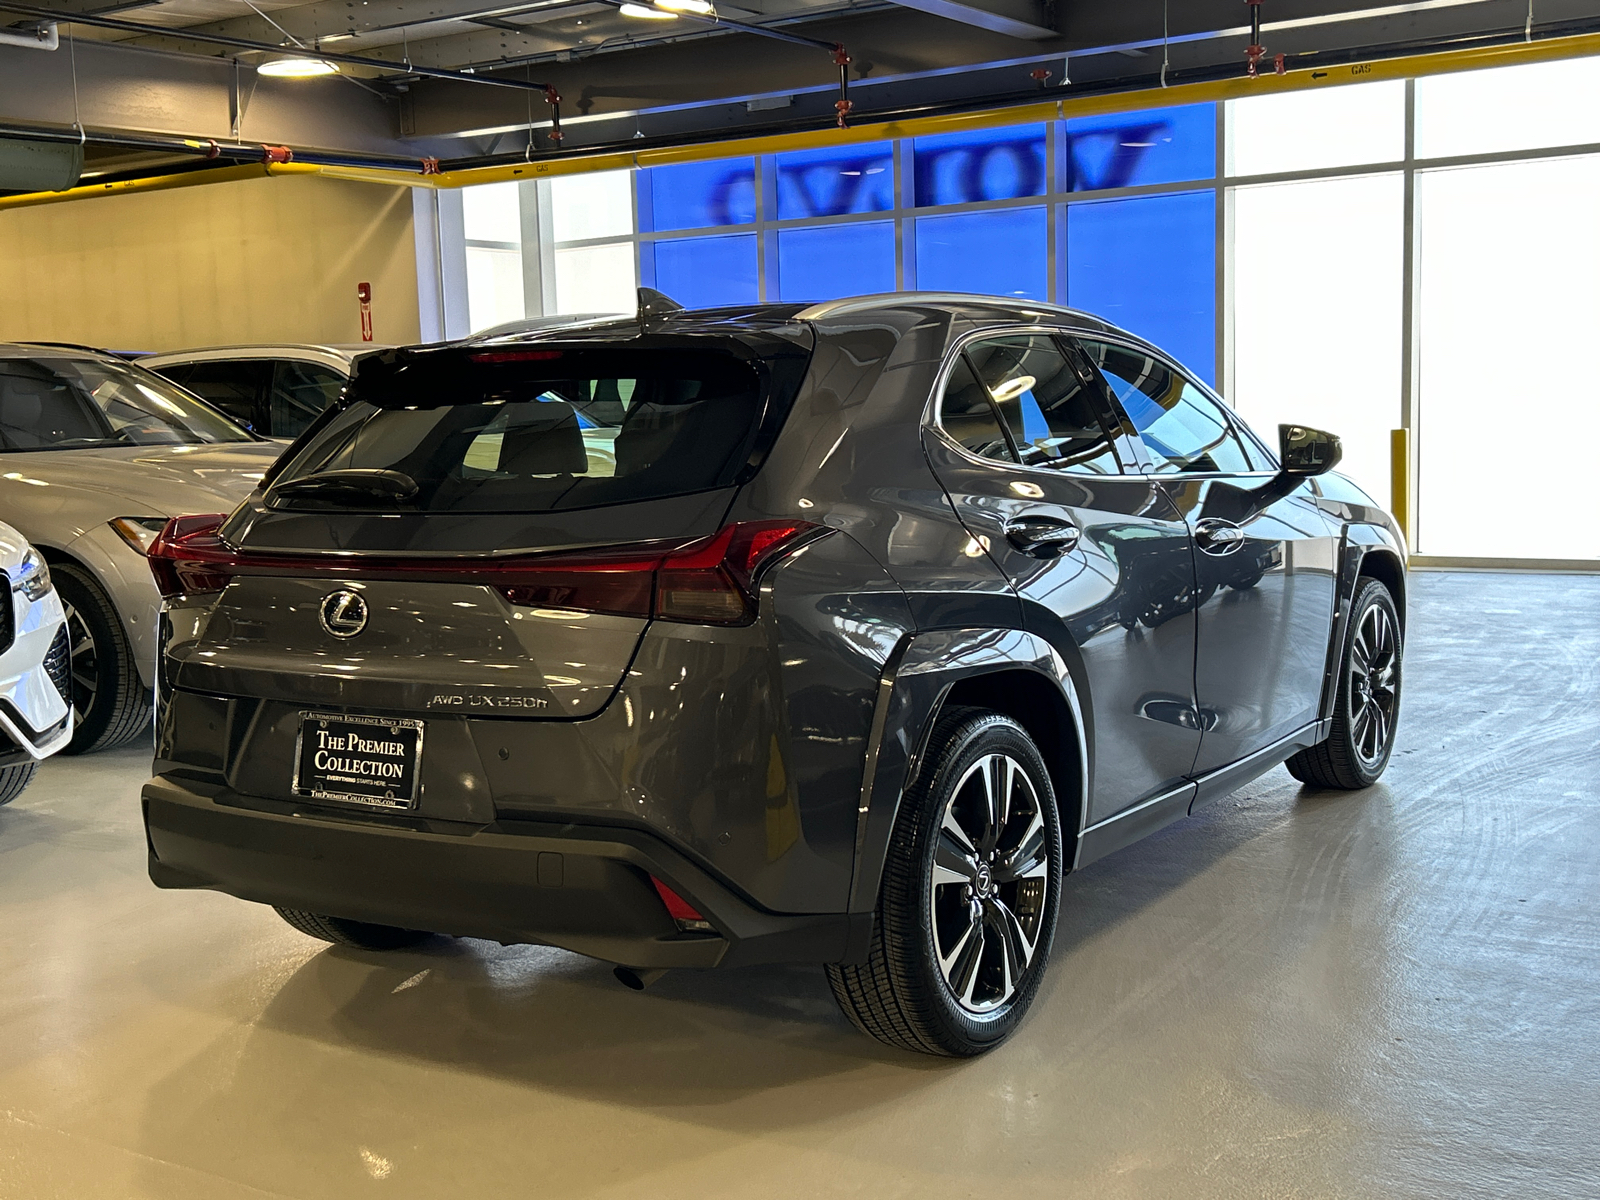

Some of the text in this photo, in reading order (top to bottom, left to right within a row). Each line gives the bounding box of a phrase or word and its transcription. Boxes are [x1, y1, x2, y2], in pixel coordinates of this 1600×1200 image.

[1351, 64, 1371, 75] GAS
[536, 164, 549, 173] GAS
[432, 694, 548, 709] AWD UX 250h
[307, 712, 343, 721] AUTOMOTIVE
[344, 714, 378, 725] EXCELLENCE
[380, 718, 397, 726] SINCE
[316, 730, 405, 757] THE PREMIER
[314, 750, 404, 779] COLLECTION
[326, 774, 356, 784] EVERYTHING
